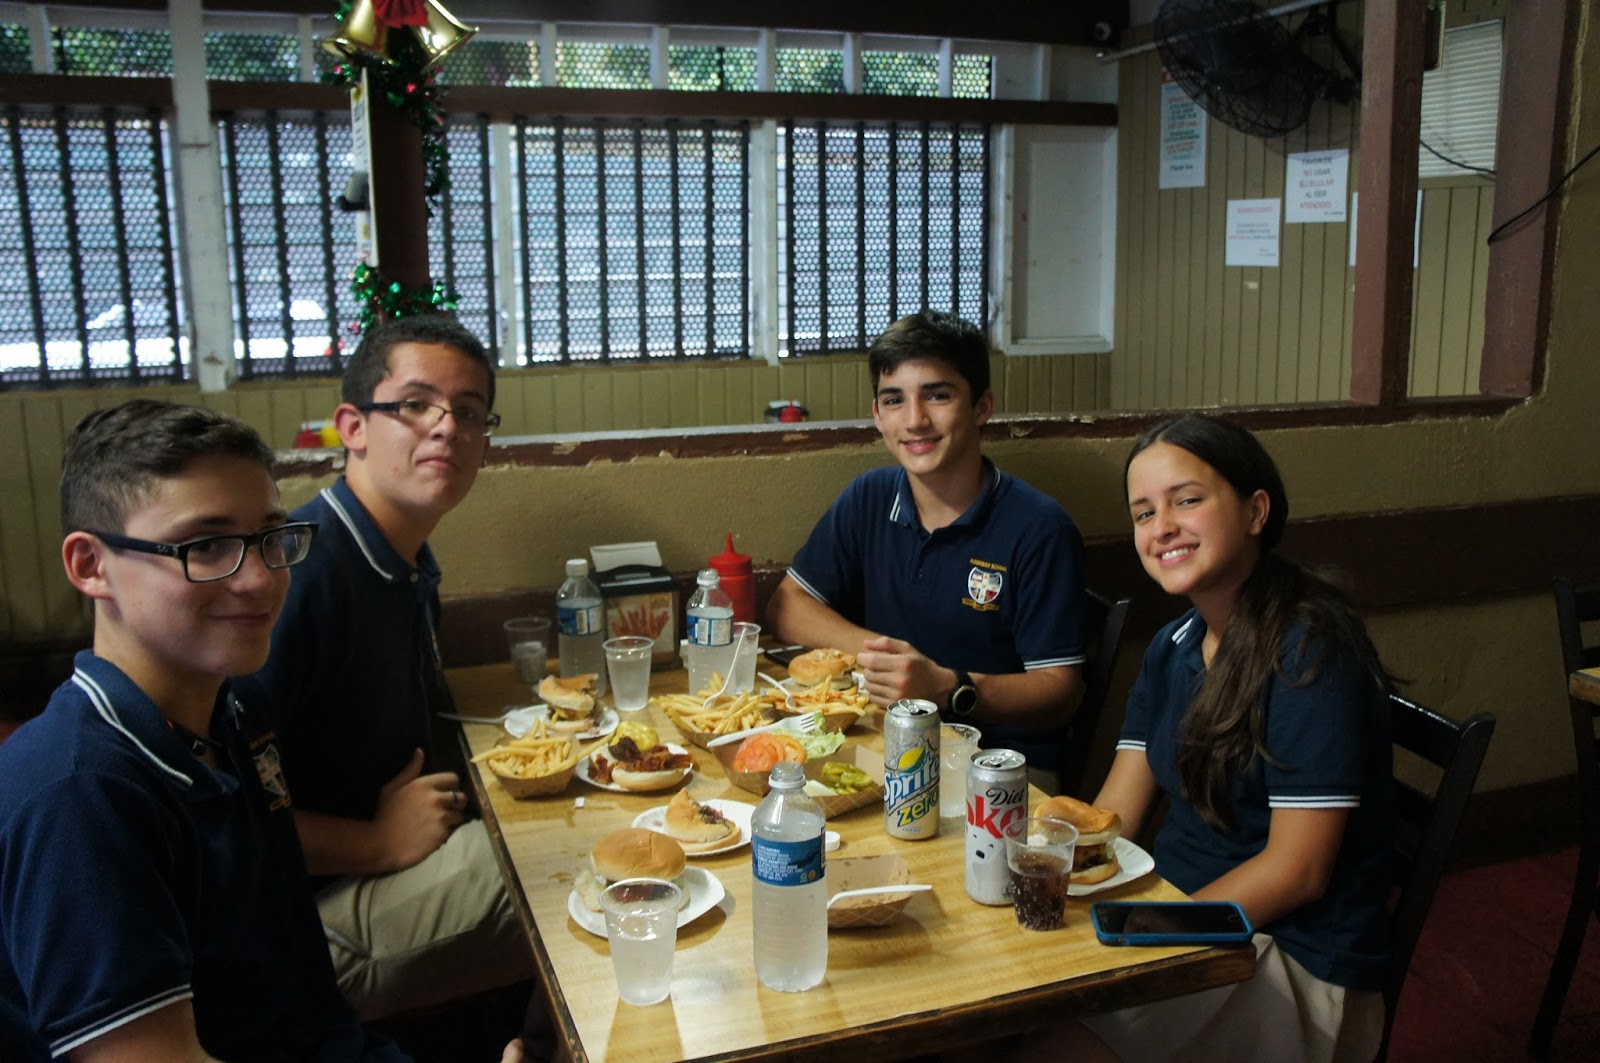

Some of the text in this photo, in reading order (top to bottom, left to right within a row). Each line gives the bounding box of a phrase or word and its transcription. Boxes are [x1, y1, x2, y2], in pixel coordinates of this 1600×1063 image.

[1313, 168, 1331, 176] USAR
[1314, 190, 1327, 198] SER
[884, 753, 940, 810] Sprite
[985, 787, 1025, 806] Diet
[897, 785, 939, 828] zero
[966, 795, 1025, 840] ke
